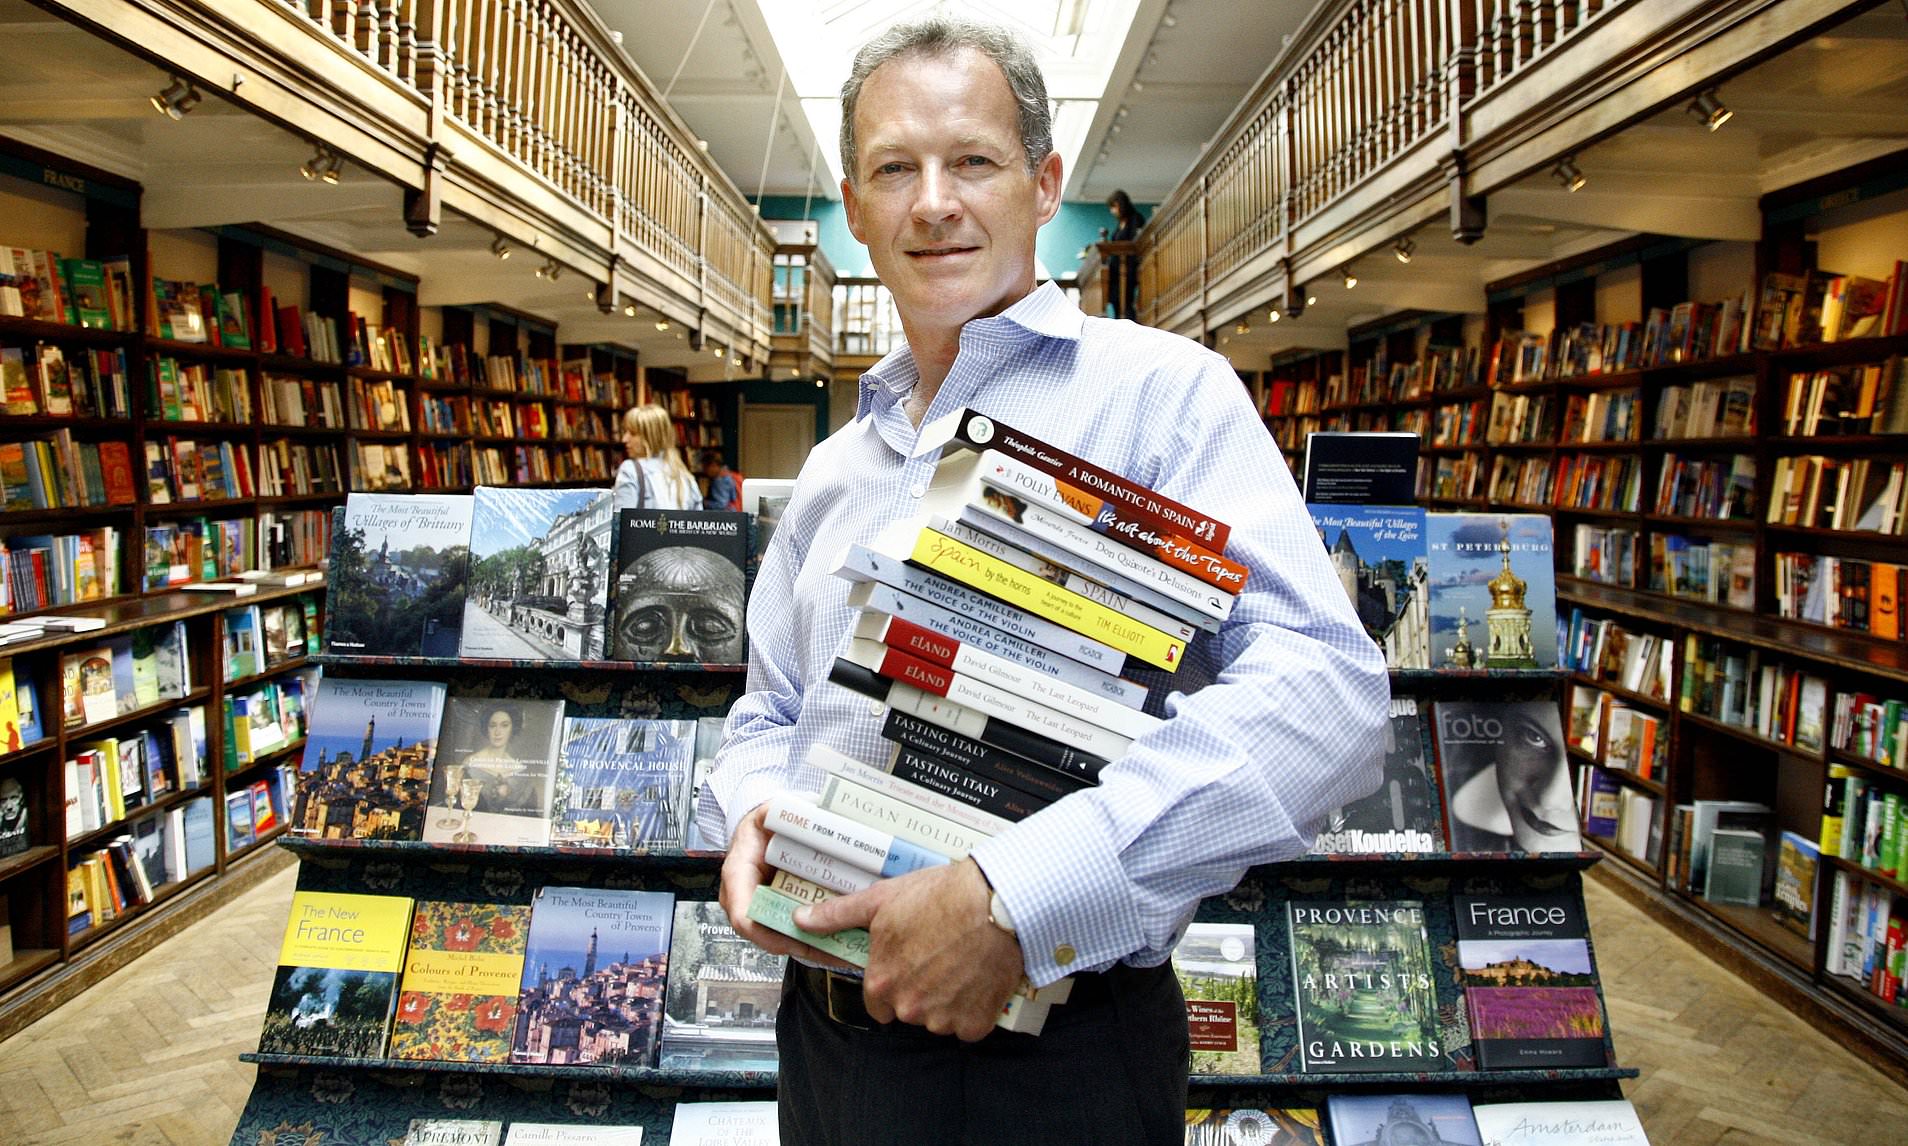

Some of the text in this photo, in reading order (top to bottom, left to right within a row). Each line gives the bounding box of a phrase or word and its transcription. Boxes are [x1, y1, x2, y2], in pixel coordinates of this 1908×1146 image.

[44, 169, 86, 193] FRANCE
[1037, 451, 1064, 468] Gautier
[1015, 472, 1092, 515] POLLY EVANS
[1068, 467, 1196, 530] A ROMANTIC IN SPAIN
[370, 503, 450, 516] The Most Beautiful
[352, 514, 465, 534] Villages of Brittany
[630, 519, 657, 529] ROME
[668, 520, 686, 530] THE
[1344, 517, 1383, 530] Beautiful
[1374, 530, 1419, 541] of the Loire
[942, 519, 1007, 555] Jan Morris
[1097, 509, 1243, 583] It's not about the Tapas
[1432, 543, 1549, 552] ST PETERSBURG
[930, 536, 1032, 596] Spain by the horns
[1095, 541, 1203, 599] Don Quixote's Delusions
[904, 579, 925, 593] THE
[928, 589, 960, 608] VOICE
[960, 601, 976, 613] OF
[977, 609, 998, 623] THE
[1001, 618, 1037, 638] VIOLIN
[923, 576, 1024, 622] ANDREA CAMILLERI
[1081, 583, 1129, 611] SPAIN
[949, 616, 1047, 660] ANDREA CAMILLERI
[1096, 616, 1147, 645] TIM ELLIOTT
[928, 618, 949, 633] THE
[952, 627, 986, 647] VOICE
[985, 641, 1000, 653] OF
[1002, 647, 1023, 662] THE
[1025, 656, 1060, 676] VIOLIN
[333, 687, 413, 699] The Most Beautiful
[962, 654, 987, 671] David
[988, 664, 1023, 683] Gilmour
[1031, 681, 1047, 694] The
[1048, 688, 1065, 702] Last
[1066, 694, 1100, 714] Leopard
[364, 699, 426, 710] Country Towns
[387, 709, 397, 718] of
[957, 683, 982, 699] David
[982, 693, 1017, 712] Gilmour
[1026, 709, 1041, 722] The
[1042, 717, 1059, 730] Last
[1060, 723, 1093, 743] Leopard
[1389, 698, 1418, 719] gue
[894, 714, 989, 759] TASTING ITALY
[1442, 711, 1503, 738] foto
[900, 732, 971, 764] A Culinary Journey
[648, 761, 686, 771] HOUSE
[905, 754, 960, 782] TASTING
[962, 774, 999, 799] ITALY
[911, 771, 982, 804] A Culinary Journey
[840, 792, 974, 850] PAGAN HOLIDA
[779, 809, 901, 863] ROME FROM THE GROUND UP
[813, 851, 835, 866] THE
[778, 874, 809, 899] Iain
[302, 904, 360, 920] The New
[551, 895, 638, 911] The Most Beautiful
[584, 908, 653, 921] Country Towns
[1470, 902, 1566, 926] France
[610, 920, 622, 930] of
[1295, 908, 1423, 924] PROVENCE
[296, 920, 365, 944] France
[410, 962, 519, 979] Colours of Provence
[1188, 1013, 1208, 1023] thern
[1310, 1041, 1440, 1058] GARDENS
[411, 1130, 492, 1144] APREMONT
[514, 1128, 554, 1141] Camille
[1507, 1117, 1634, 1138] Amsterdam
